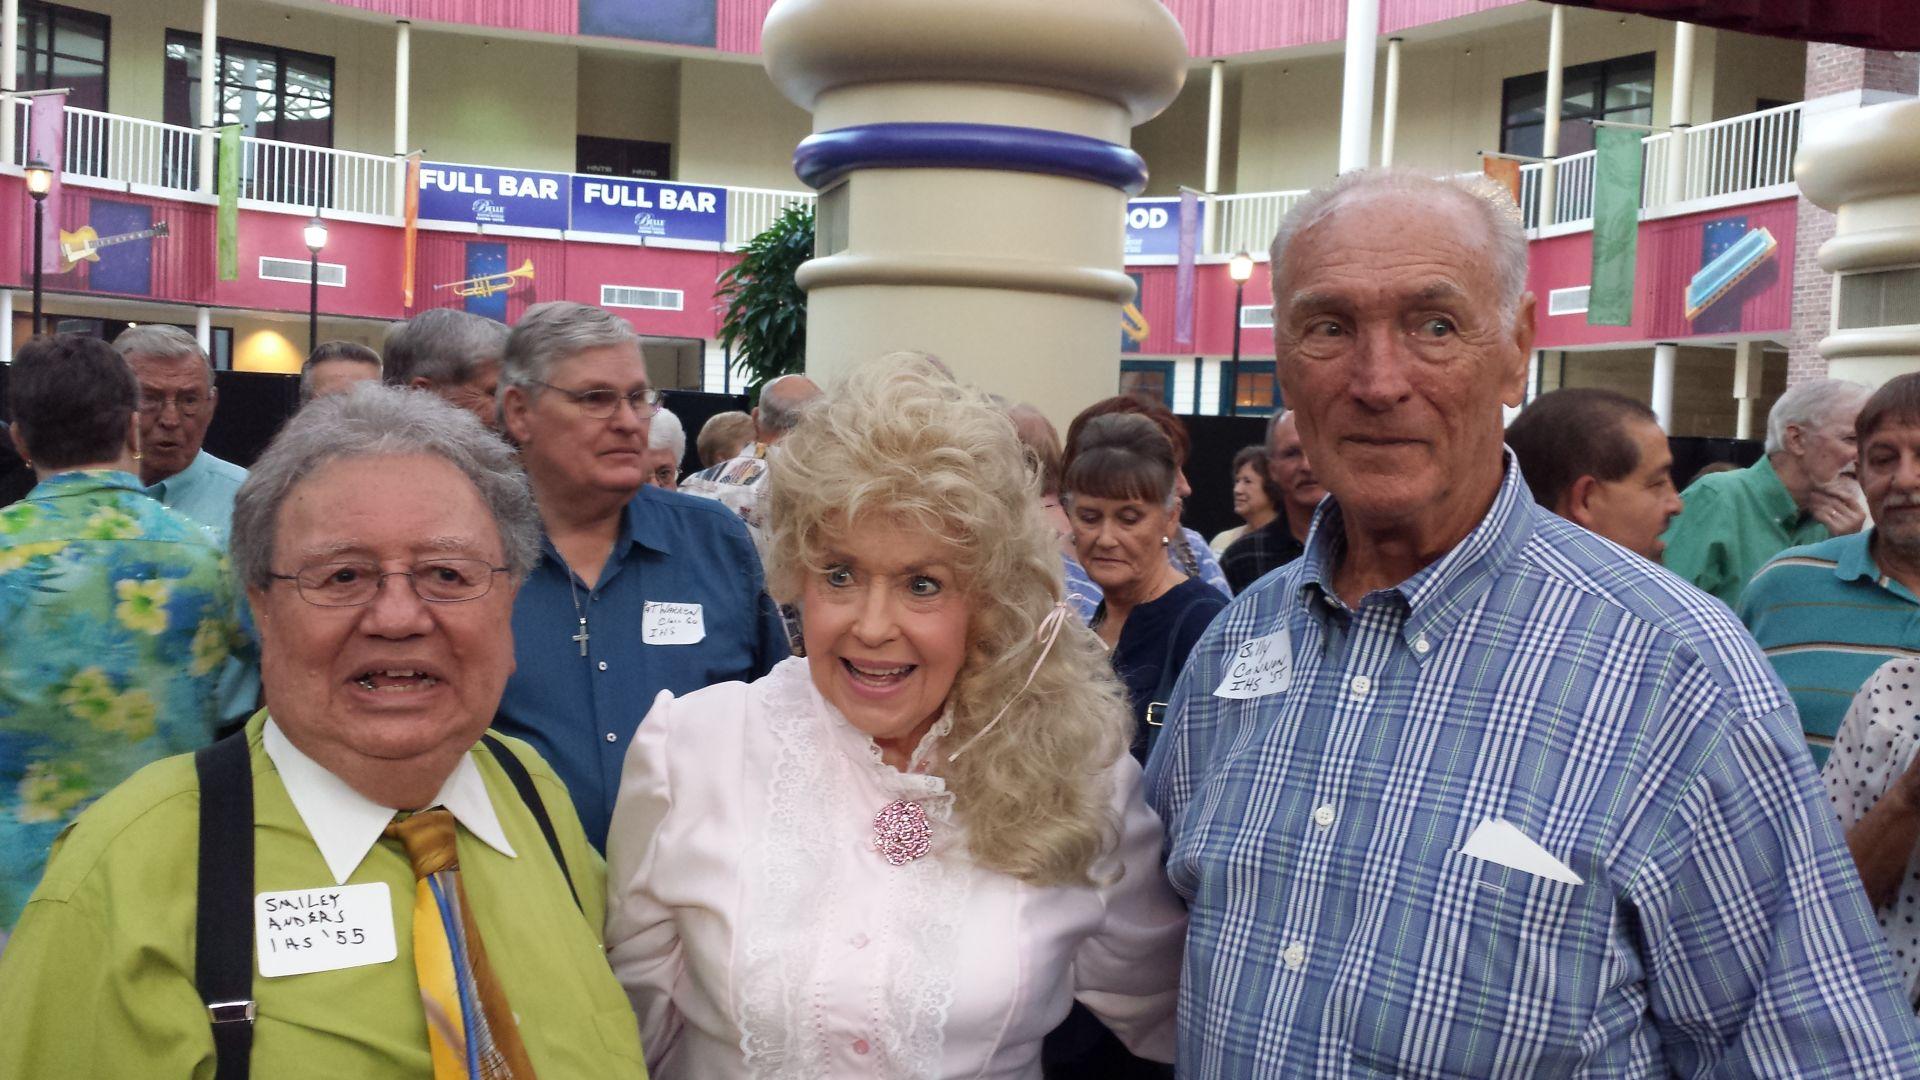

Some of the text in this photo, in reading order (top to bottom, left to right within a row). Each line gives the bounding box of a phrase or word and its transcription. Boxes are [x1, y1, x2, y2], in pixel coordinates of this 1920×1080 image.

[419, 169, 558, 200] FULL BAR
[584, 183, 716, 213] FULL BAR
[1125, 207, 1169, 229] OD
[1229, 677, 1263, 692] IHS
[264, 893, 341, 912] SMILEY
[268, 910, 345, 931] ANDERS
[270, 928, 366, 953] IHS '55
